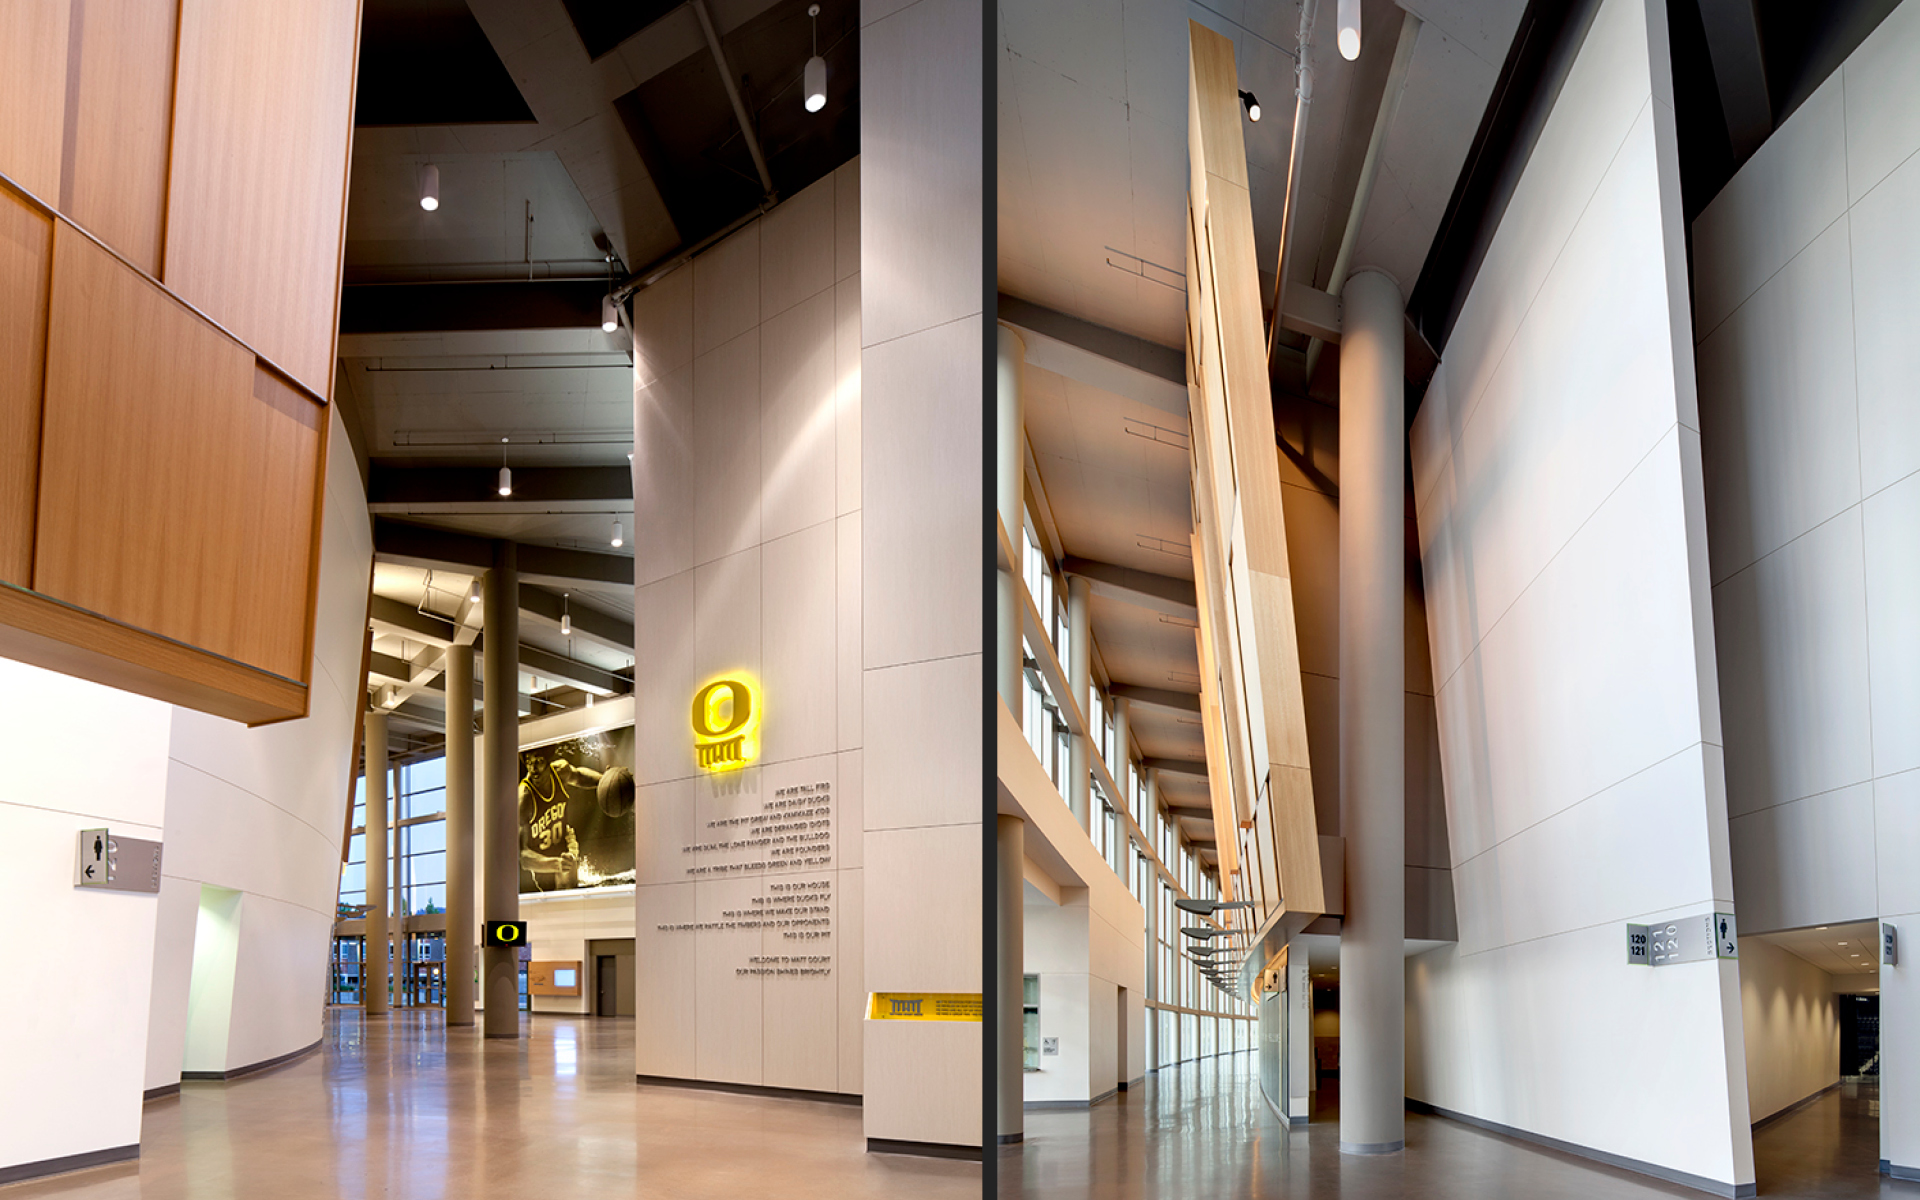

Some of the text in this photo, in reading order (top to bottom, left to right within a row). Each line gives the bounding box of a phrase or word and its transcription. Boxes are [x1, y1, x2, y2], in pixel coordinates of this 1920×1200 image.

[692, 681, 751, 736] O
[539, 821, 562, 850] 30
[496, 924, 520, 942] O
[1630, 934, 1646, 944] 120
[1652, 930, 1665, 962] 121
[1665, 924, 1678, 960] 120
[1630, 946, 1646, 956] 121
